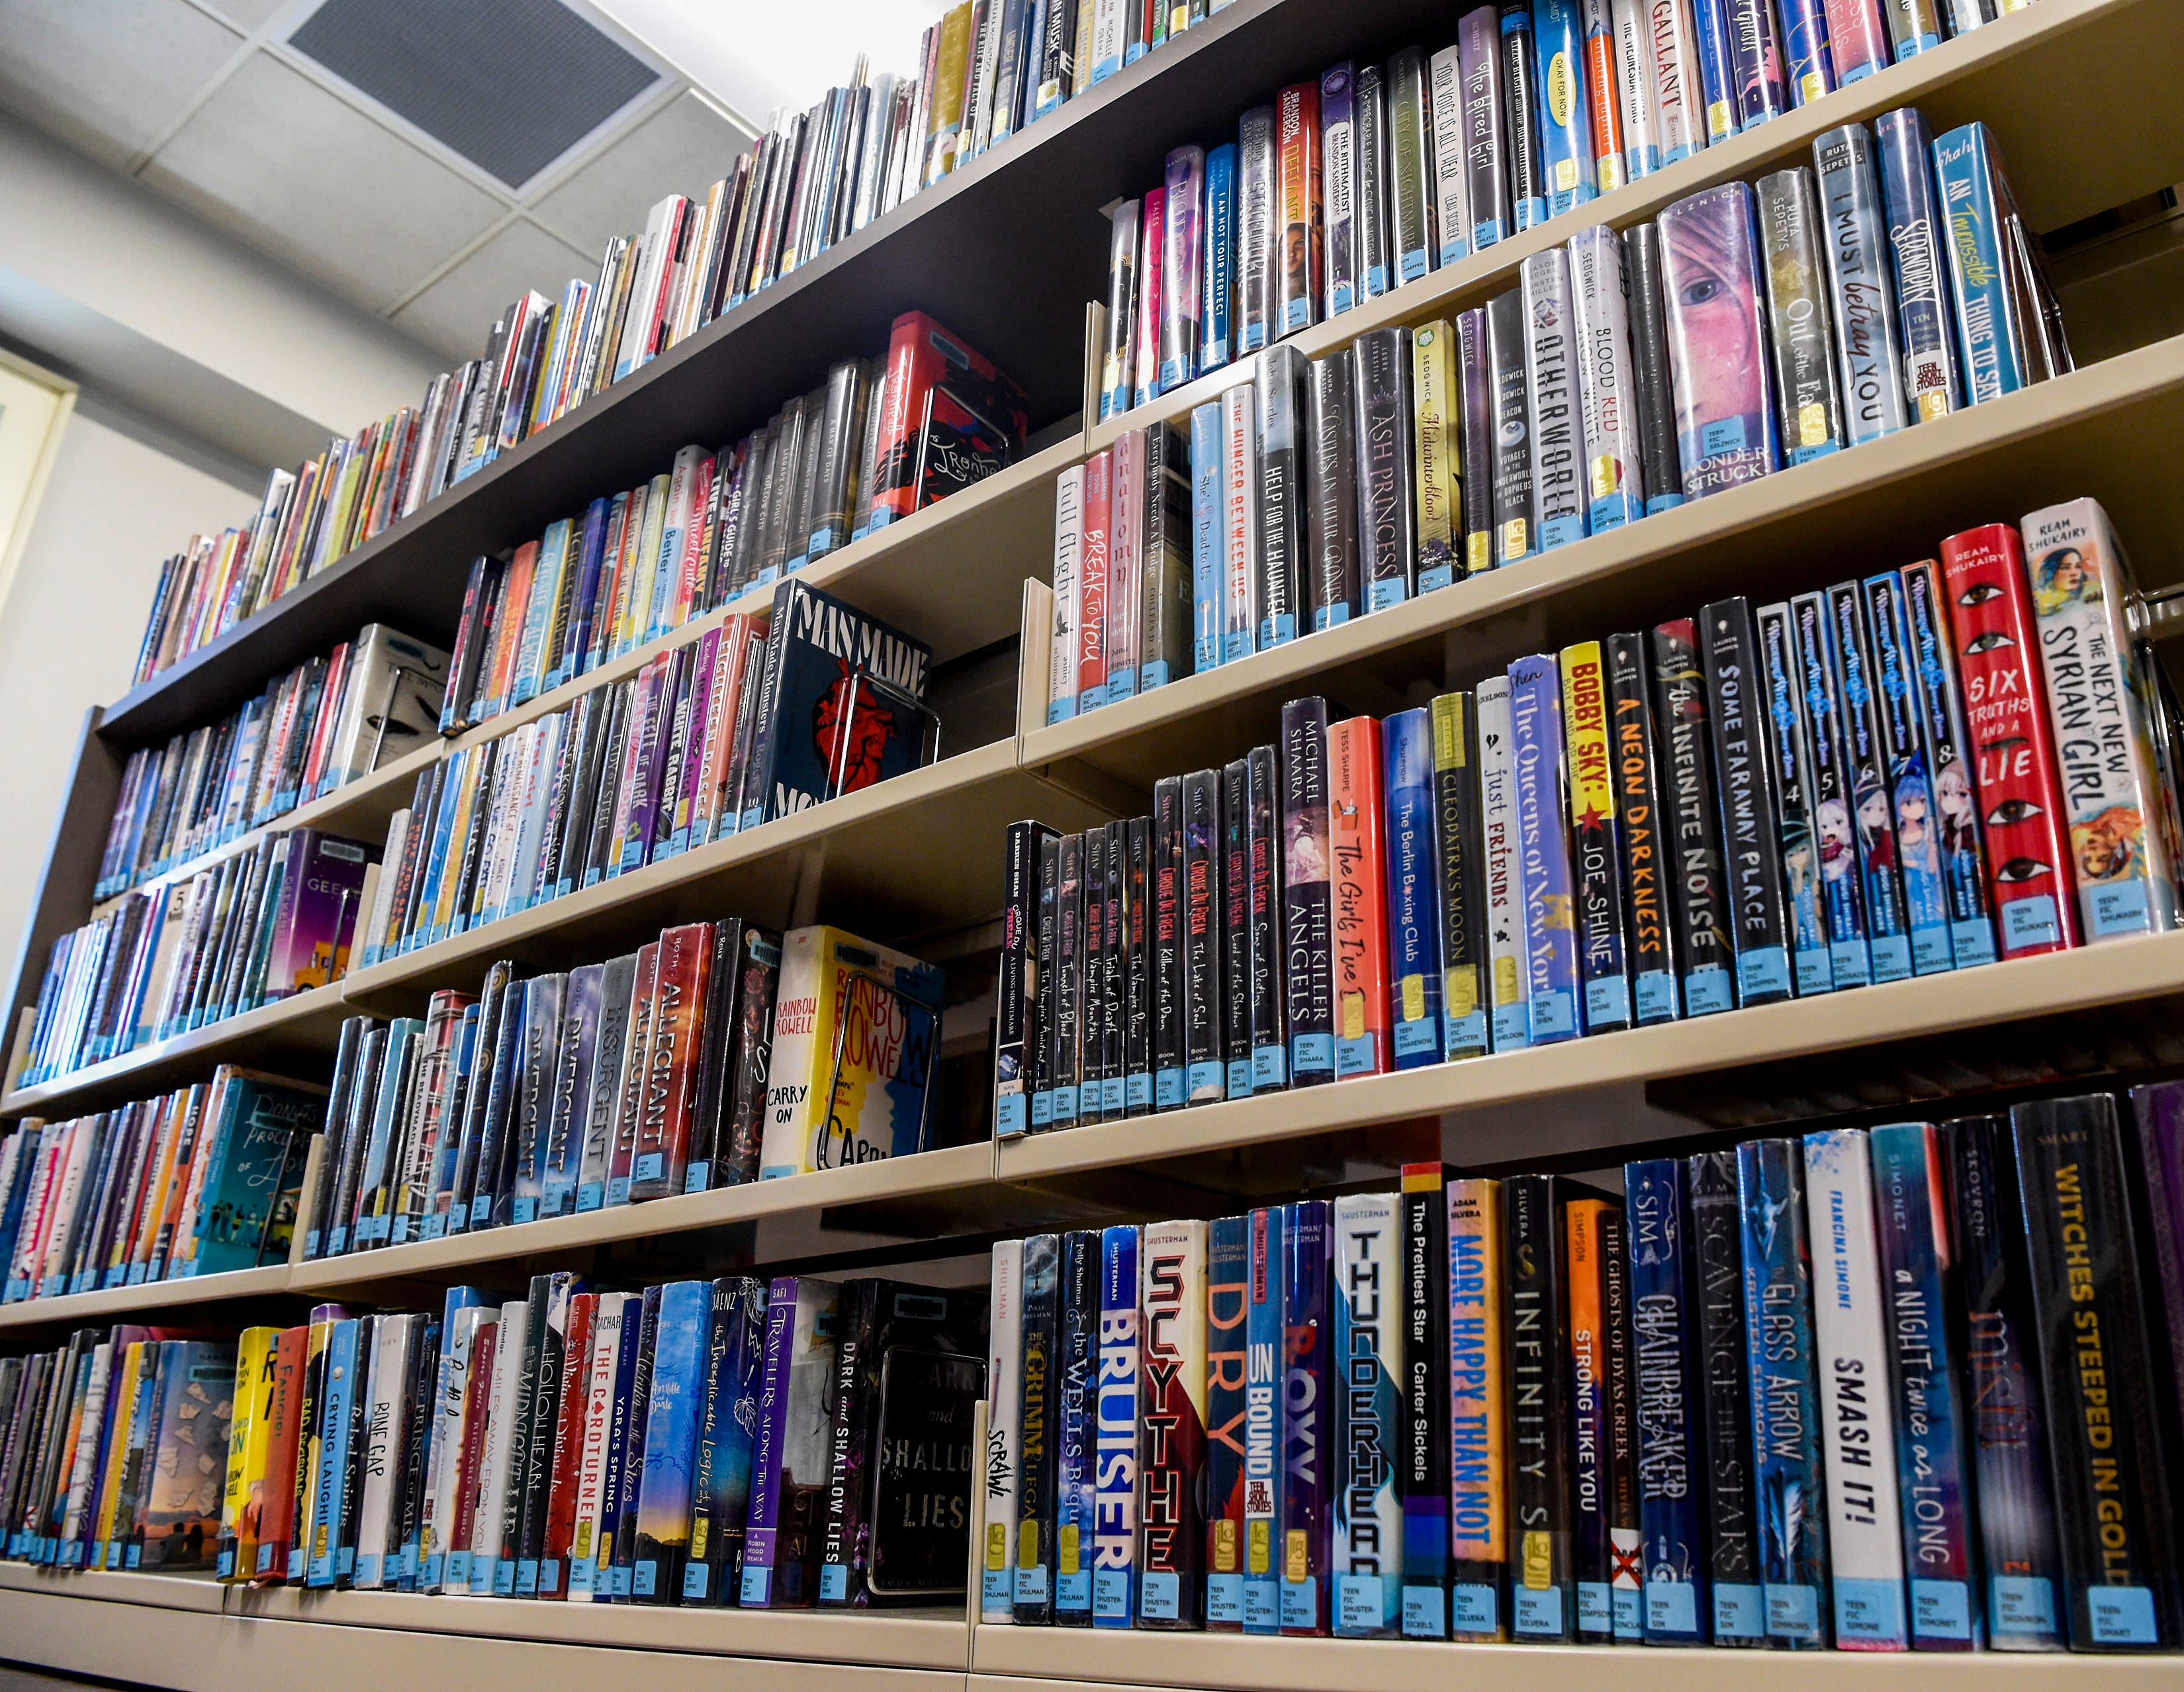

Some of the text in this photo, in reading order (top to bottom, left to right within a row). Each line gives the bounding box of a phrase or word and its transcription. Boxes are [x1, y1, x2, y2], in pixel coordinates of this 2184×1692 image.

[1095, 28, 1105, 57] OBAMA
[1435, 62, 1457, 182] YOUR ALL HEAR
[1559, 99, 1567, 117] NOW
[1219, 200, 1226, 213] AM
[1340, 149, 1350, 212] RITHMATIST
[1773, 197, 1789, 250] SEPETYS
[1786, 203, 1798, 237] RUTA
[1216, 263, 1224, 316] PERFECT
[1948, 178, 1997, 345] AN Impossible THING
[1836, 211, 1884, 422] MUST betray YOU
[1596, 328, 1619, 432] BLOOD RED
[1917, 378, 1946, 390] STORIES
[1199, 477, 1210, 502] She's
[1265, 466, 1283, 548] HELP FOR THE
[1369, 414, 1398, 577] ASH PRINCESS
[1421, 412, 1443, 522] Midwinterblood
[660, 530, 676, 573] Better
[1054, 480, 1079, 605] full flight
[1200, 521, 1210, 548] Dead
[1081, 530, 1104, 665] BREAK YOU
[759, 606, 784, 733] Man Made Monsters
[794, 589, 929, 698] MAN MADE
[1969, 669, 2019, 702] SIX
[1571, 663, 1607, 792] BOBBY SKY:
[1969, 698, 2030, 725] TRUTHS
[2044, 627, 2105, 810] SYRIAN GIRL
[2087, 634, 2129, 775] THE NEXT NEW
[662, 698, 688, 812] WHITE RABBIT
[1290, 729, 1302, 800] SHAARA
[1305, 720, 1321, 804] MICHAEL
[1342, 755, 1351, 792] SHARPE
[1399, 737, 1408, 782] Sharenow
[1519, 746, 1540, 847] Queens
[1718, 666, 1766, 930] SOME FARAWAY PLACE
[1979, 749, 2032, 786] LIE
[1443, 775, 1465, 959] CLEOPATRA'S MOON
[1615, 699, 1661, 953] A NEON DARKNESS
[1672, 725, 1715, 947] INFINITE NOISE
[1335, 837, 1365, 982] The Girls I've
[1400, 802, 1418, 963] The Berlin Club
[1584, 845, 1612, 967] JOE SHINE
[717, 937, 725, 960] Roux
[1290, 905, 1310, 1021] ANGELS
[1311, 898, 1328, 1021] THE KILLER
[776, 1017, 813, 1036] ROWELL
[778, 998, 816, 1015] RAINBOW
[1193, 964, 1206, 1029] Lake Souls
[644, 982, 680, 1145] ALLEGIANT
[768, 1086, 807, 1106] CARRY
[776, 1108, 792, 1123] ON
[1146, 1235, 1188, 1245] SHUSTERMAN
[1342, 1209, 1390, 1219] SHUSTERMAN
[1450, 1210, 1480, 1219] SILVERA
[1453, 1198, 1477, 1207] ADAM
[1574, 1213, 1585, 1262] SIMPSON
[1637, 1195, 1658, 1244] SIM
[999, 1258, 1008, 1320] SHULMAN
[1831, 1191, 1852, 1309] FRANCINA SIMONE
[772, 1288, 786, 1299] SAFI
[2056, 1164, 2117, 1491] WITCHES STEEPED IN
[594, 1345, 612, 1381] THE
[840, 1342, 856, 1388] DARK
[1207, 1284, 1247, 1460] DRY
[1413, 1201, 1426, 1481] The Prettiest Star Carter Sickels
[324, 1393, 340, 1452] CRYING
[705, 1343, 725, 1433] Inexplicable
[754, 1308, 786, 1522] TRAVELERS ALONG WAY
[1143, 1254, 1185, 1573] SCYTHE
[1451, 1235, 1490, 1544] MORE HAPPY THAN NOT
[1514, 1292, 1546, 1479] INFINITY
[1574, 1329, 1596, 1513] STRONG LIKE YOU
[1895, 1291, 1950, 1565] NIGHT twice LONG
[366, 1402, 390, 1476] BONE GAP
[606, 1397, 625, 1513] YARA'S SPRING
[830, 1428, 848, 1514] SHALLOW
[987, 1429, 1015, 1499] SCRAWL
[1093, 1309, 1136, 1568] BRUISER
[1834, 1358, 1876, 1525] SMASH IT!
[826, 1523, 841, 1564] LIES
